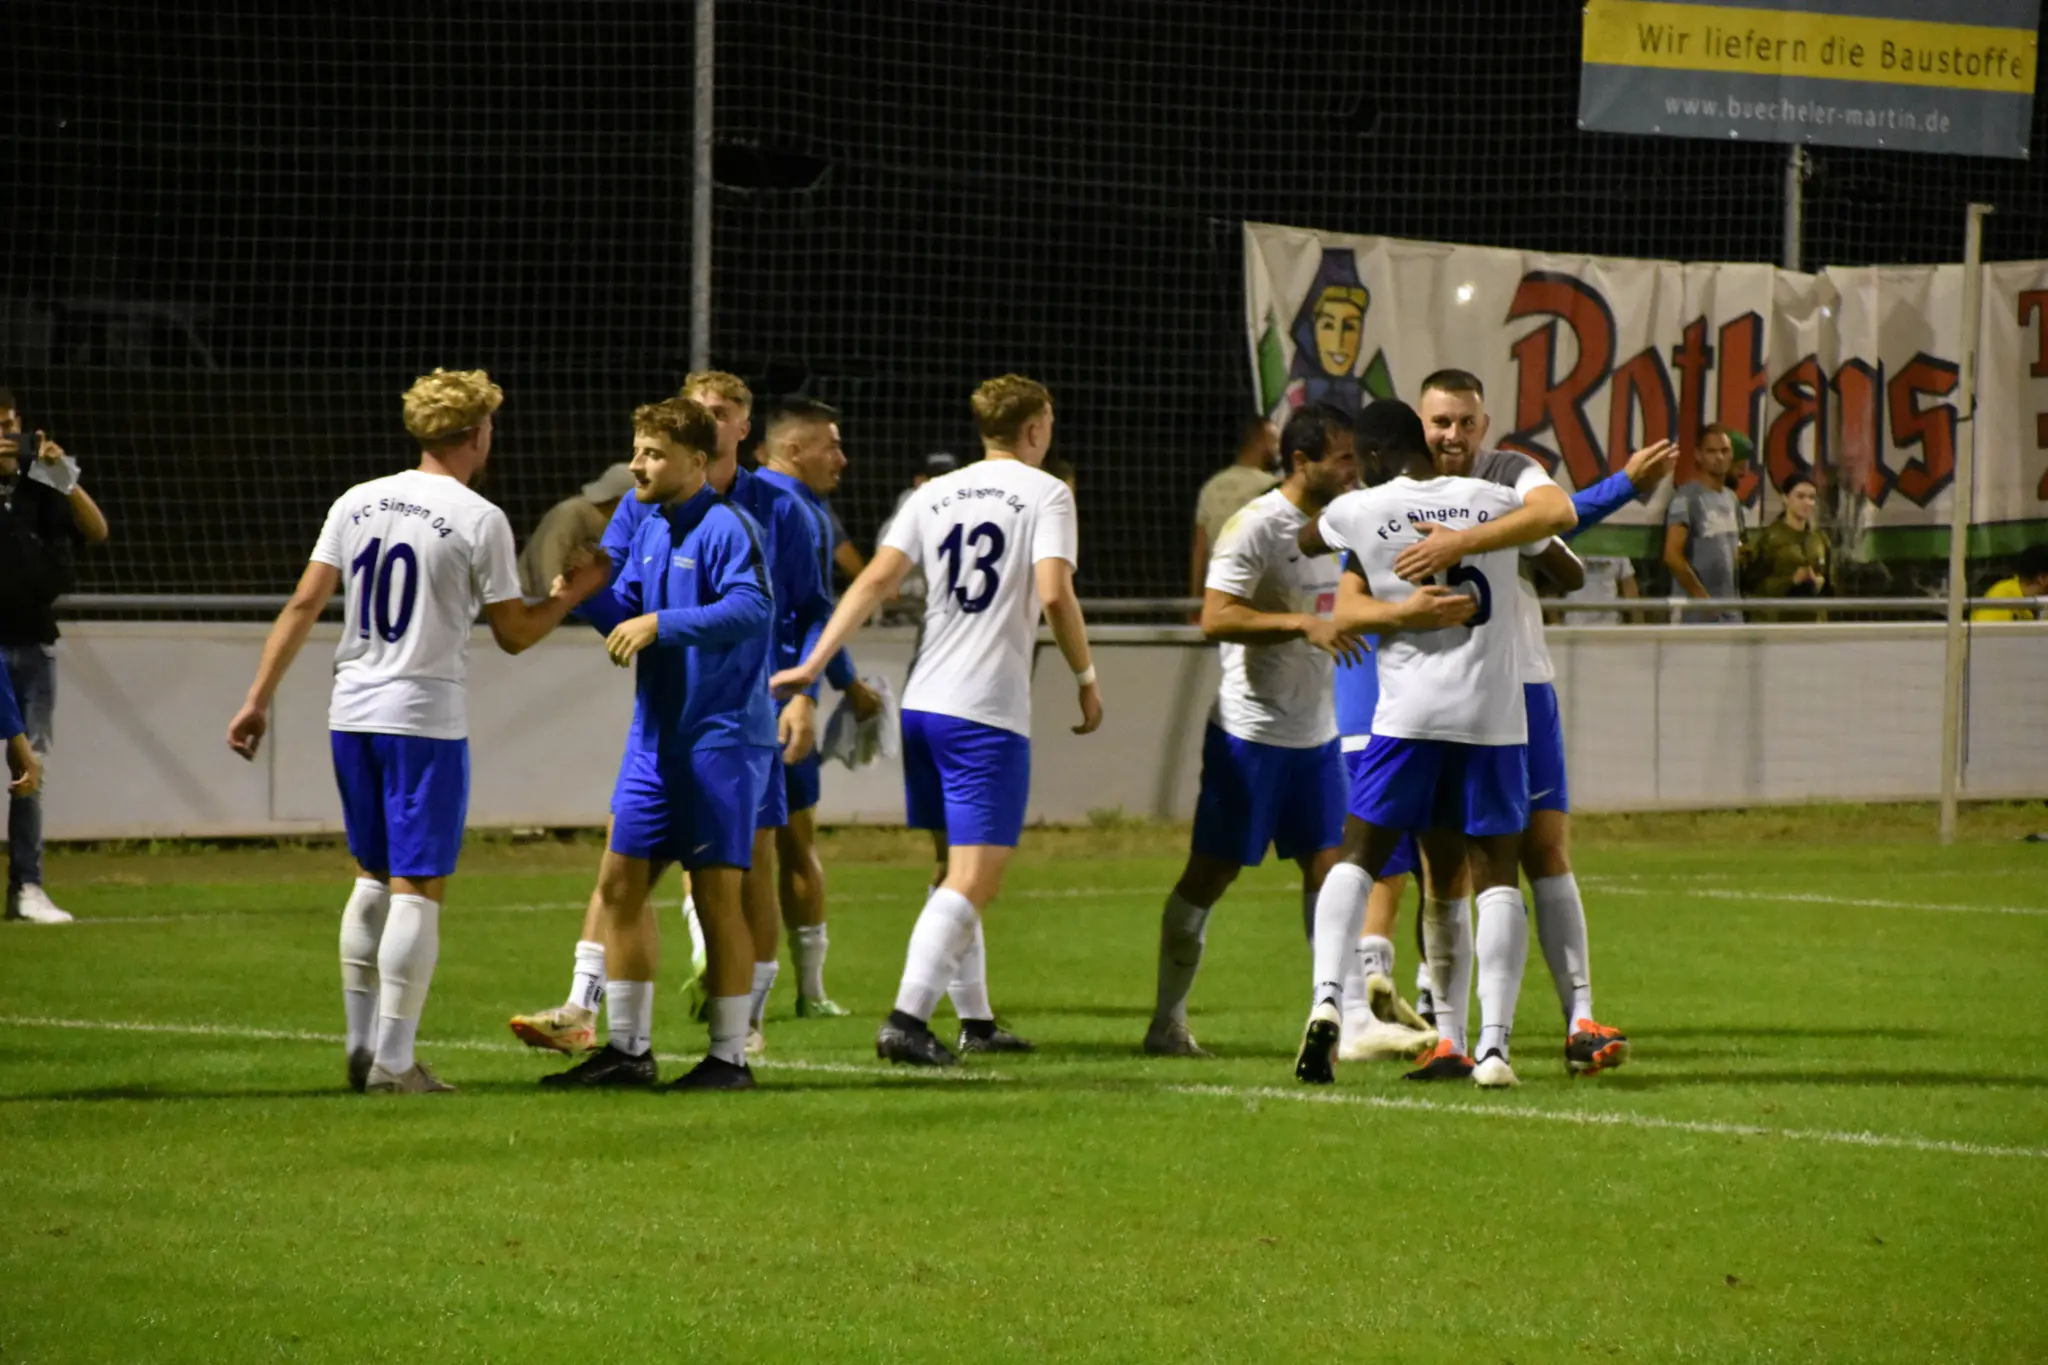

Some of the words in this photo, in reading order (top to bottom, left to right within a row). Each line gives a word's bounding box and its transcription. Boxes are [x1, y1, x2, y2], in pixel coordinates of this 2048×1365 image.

[1637, 23, 1691, 54] Wir
[1705, 27, 1807, 63] liefern
[1821, 35, 1865, 68] die
[1880, 39, 2024, 80] Baustoffe
[1664, 94, 1951, 134] www.buecheler-martin.de
[352, 504, 373, 526] FC
[379, 498, 430, 520] Singen
[432, 516, 453, 538] 04
[930, 496, 951, 516] FC
[956, 487, 1005, 501] Singen
[1006, 495, 1027, 514] 04
[1377, 518, 1402, 541] FC
[1406, 506, 1470, 525] Singen
[937, 521, 1005, 614] 13
[352, 537, 418, 644] 10
